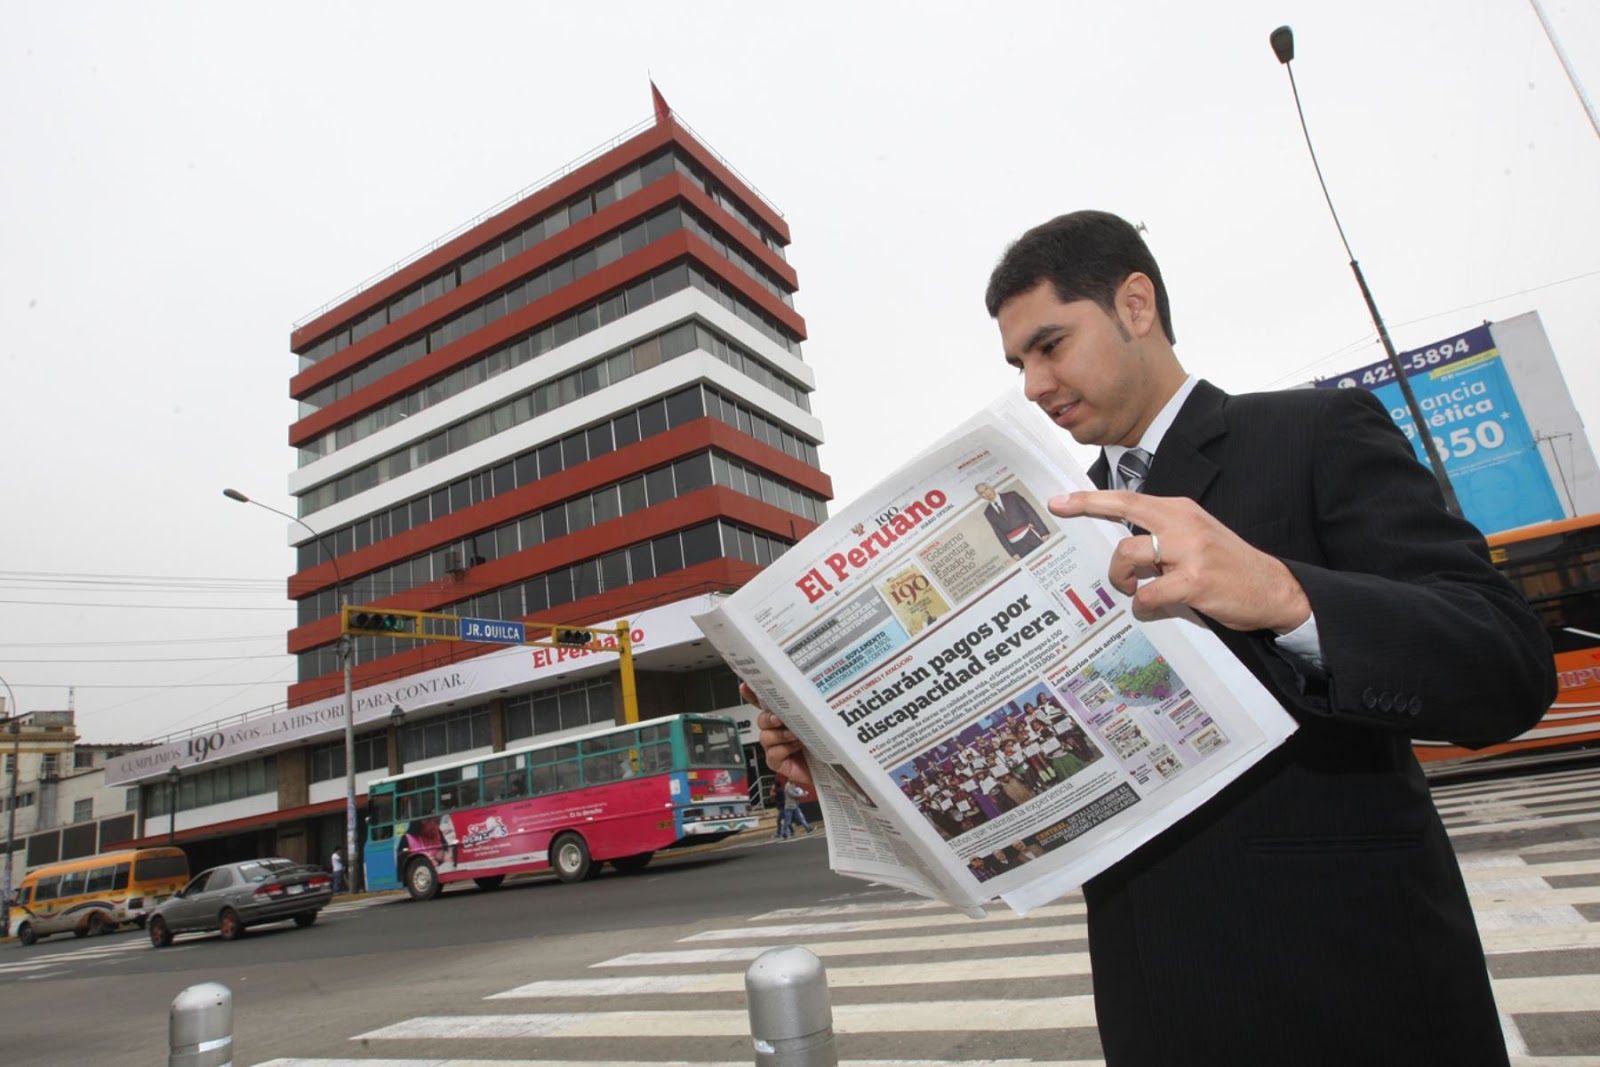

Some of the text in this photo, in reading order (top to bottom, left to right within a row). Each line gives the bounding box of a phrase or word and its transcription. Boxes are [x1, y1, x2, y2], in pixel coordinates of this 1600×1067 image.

[873, 505, 900, 531] 190
[796, 569, 833, 603] El
[824, 488, 948, 584] Peruano
[931, 542, 969, 572] garantiza
[1046, 547, 1076, 569] demanda
[935, 558, 965, 580] Estado
[964, 549, 976, 559] de
[892, 573, 932, 605] 190
[466, 623, 520, 640] JR. QUILCA
[846, 632, 885, 661] SUPLEMENTO
[532, 648, 553, 669] El
[839, 668, 930, 726] Iniciarán
[929, 624, 993, 675] pagos
[992, 595, 1031, 633] por
[885, 656, 913, 676] AYACUCHO
[945, 693, 967, 708] calidad
[995, 658, 1022, 677] Gobierno
[1022, 638, 1052, 659] entregará
[1051, 630, 1063, 640] 150
[1051, 677, 1065, 687] Los
[1063, 659, 1090, 678] diarios
[1088, 647, 1103, 660] más
[1103, 625, 1132, 648] antiguos
[828, 670, 852, 688] HISTORIA
[852, 660, 869, 674] PARA
[858, 657, 985, 743] discapacidad
[985, 611, 1059, 665] severa
[951, 699, 973, 715] primera
[990, 674, 1010, 689] Dinero
[1029, 641, 1061, 664] disponible
[997, 673, 1027, 693] beneficiar
[188, 733, 225, 762] 190
[356, 692, 394, 712] PARA
[974, 829, 987, 839] que
[987, 814, 1017, 831] valoran
[1025, 783, 1073, 812] experiencia
